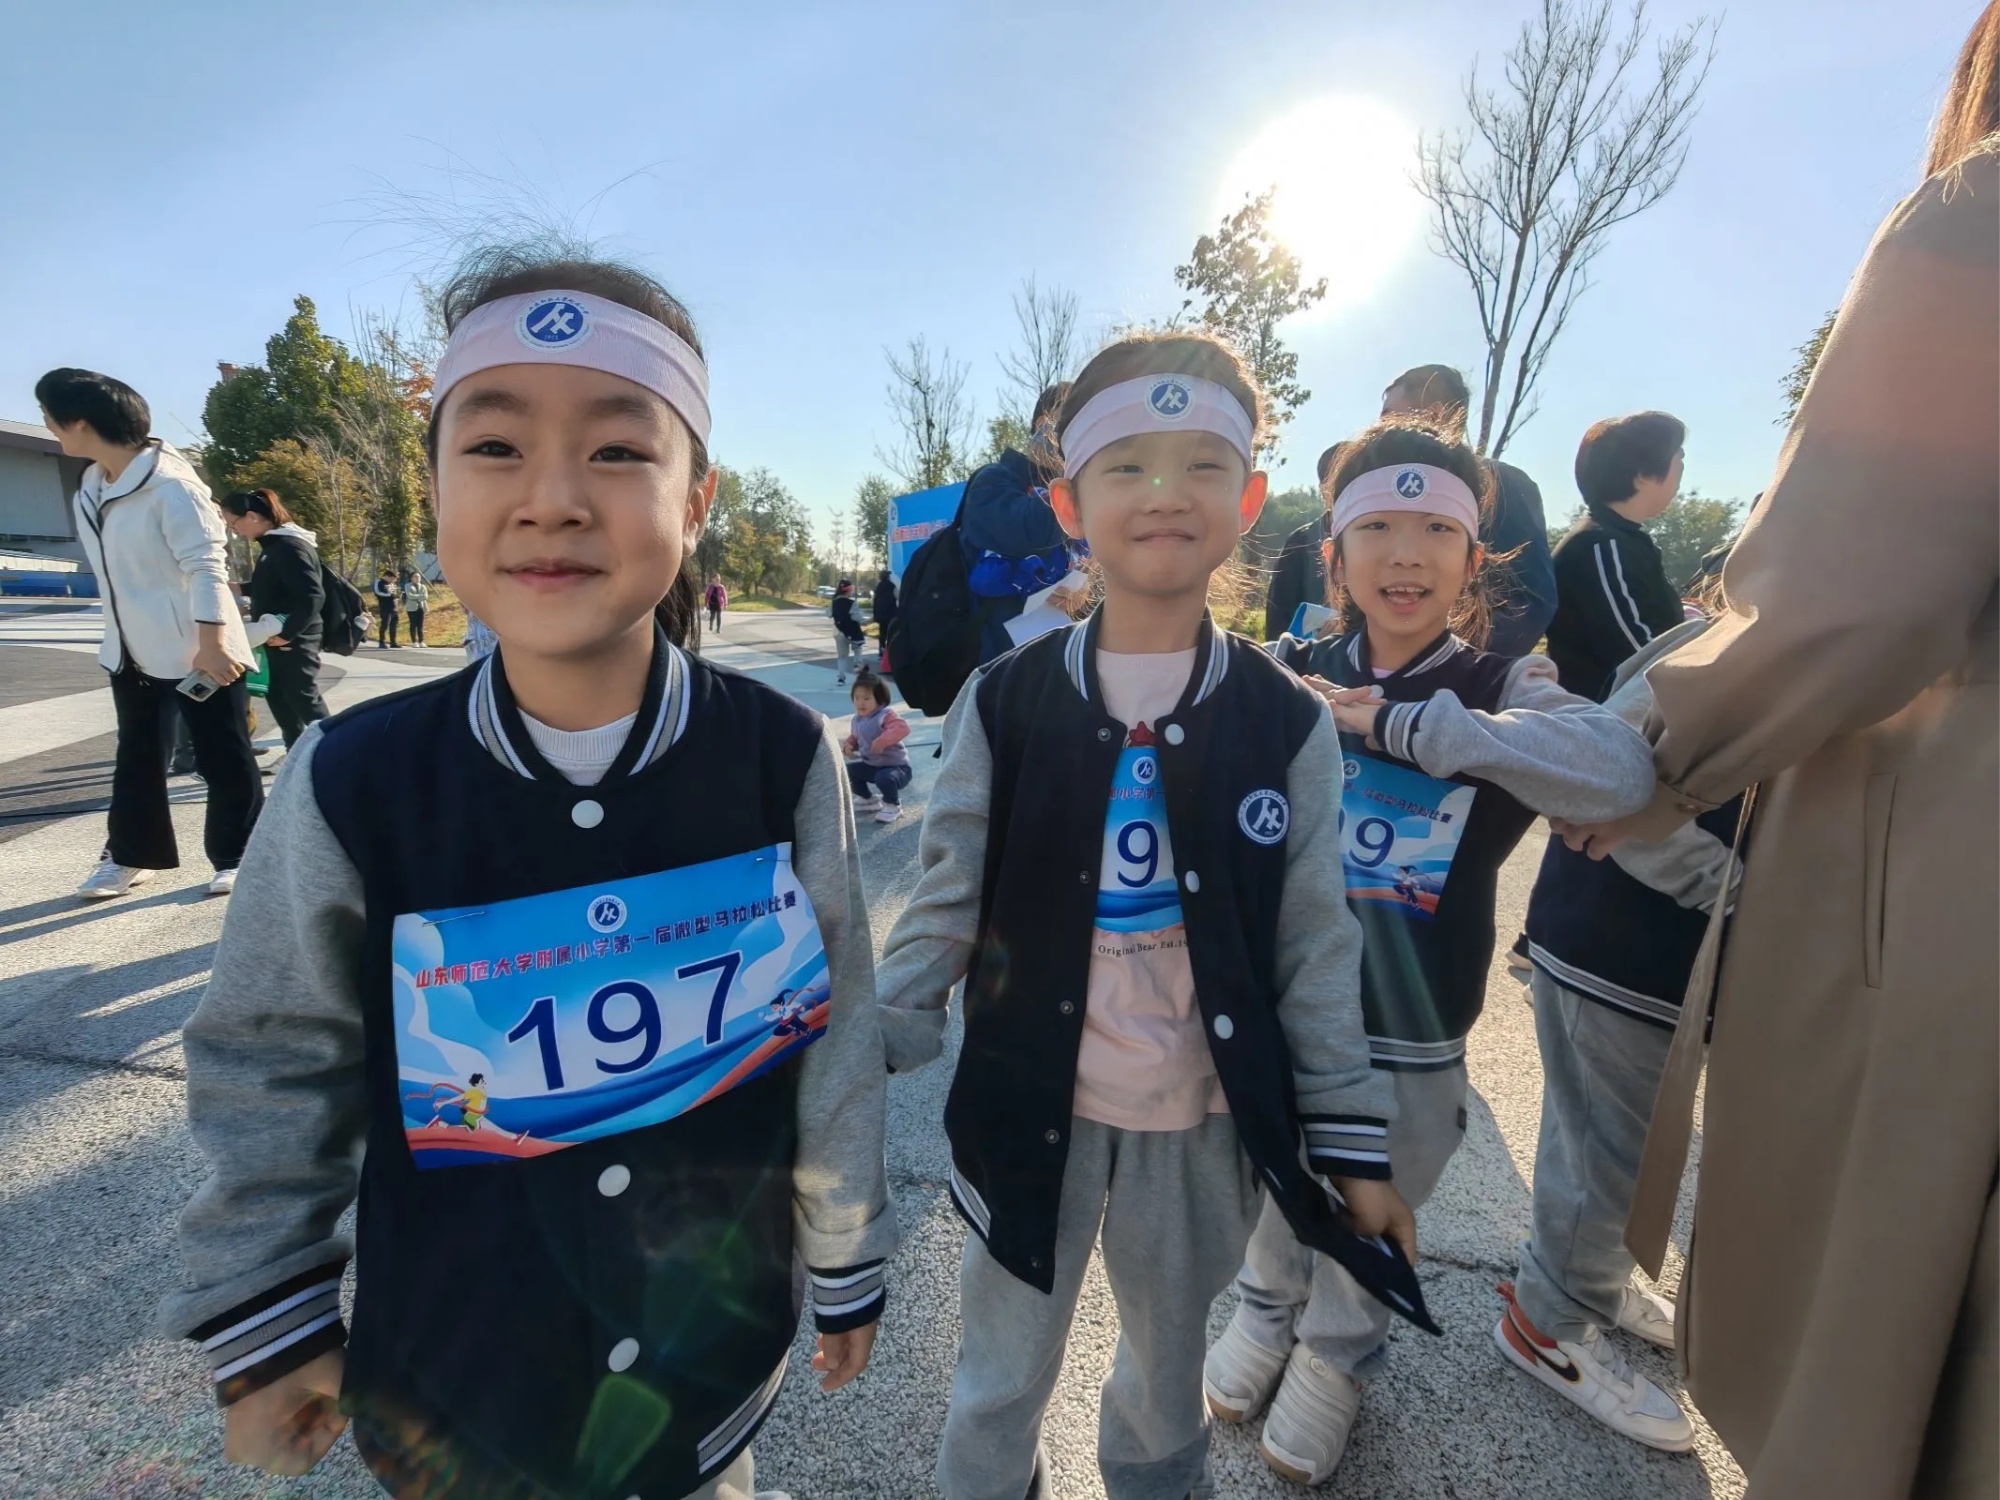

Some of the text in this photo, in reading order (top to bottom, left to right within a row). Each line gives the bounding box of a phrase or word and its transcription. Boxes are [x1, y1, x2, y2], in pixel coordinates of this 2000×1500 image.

[1338, 807, 1395, 869] 9
[415, 890, 797, 989] 山东师范大学附属小学第一届微型马拉松比赛
[1097, 944, 1136, 957] Original
[1137, 942, 1157, 953] Bear
[507, 951, 741, 1091] 197
